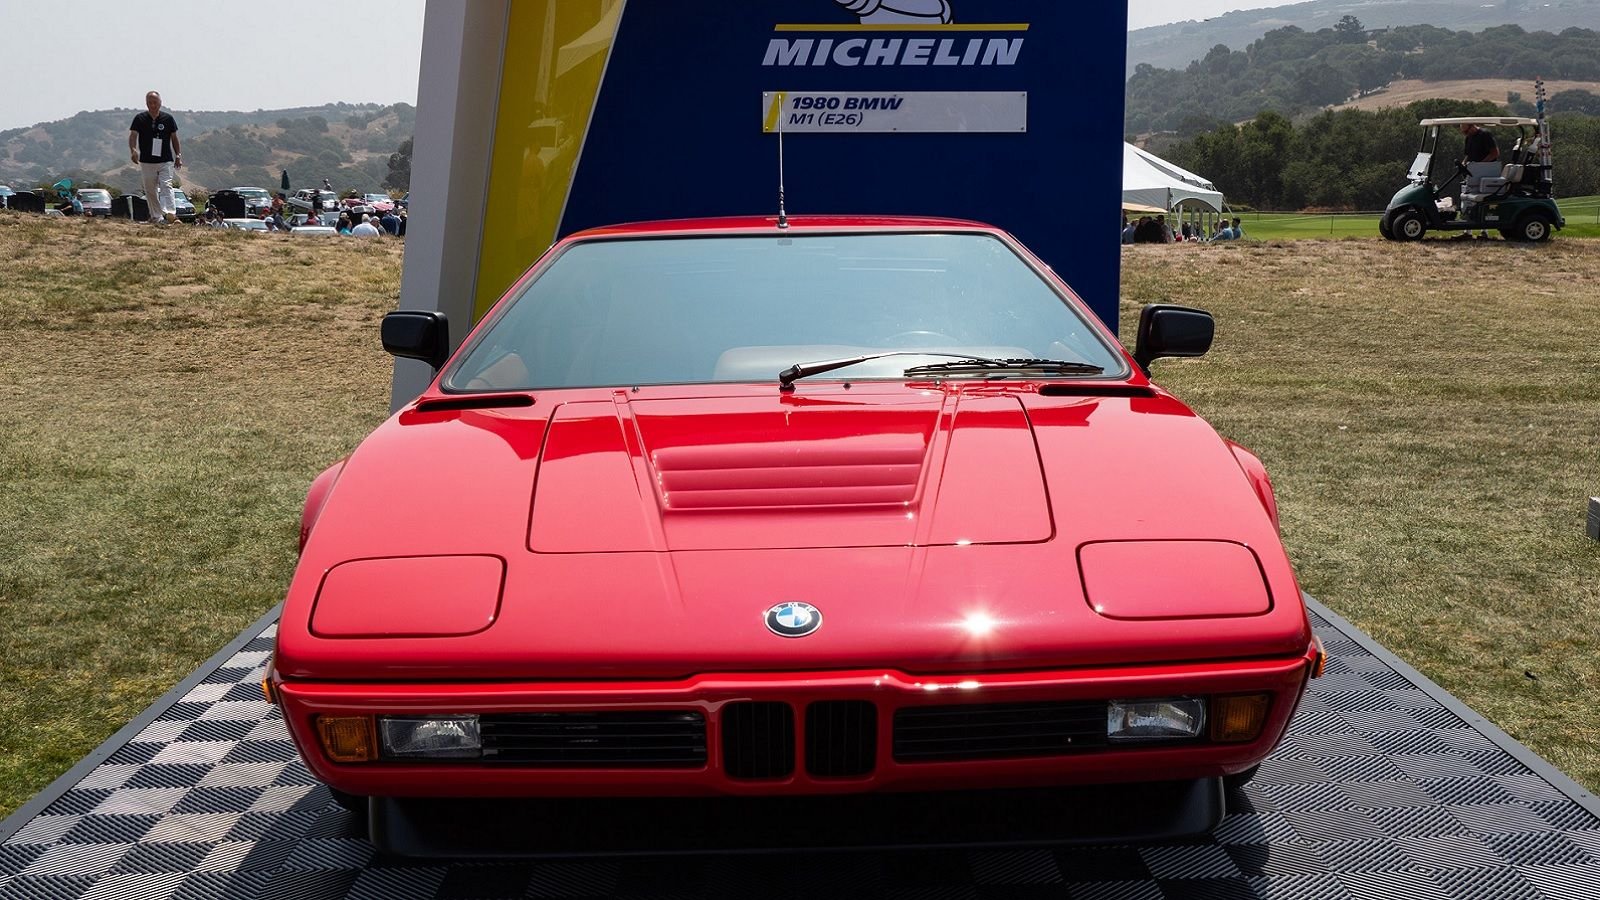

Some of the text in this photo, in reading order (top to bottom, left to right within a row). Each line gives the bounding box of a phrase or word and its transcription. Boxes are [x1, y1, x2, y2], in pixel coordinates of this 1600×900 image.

[762, 38, 1025, 66] MICHELIN
[792, 97, 904, 110] 1980 BMW
[789, 111, 863, 127] M1 (E26)
